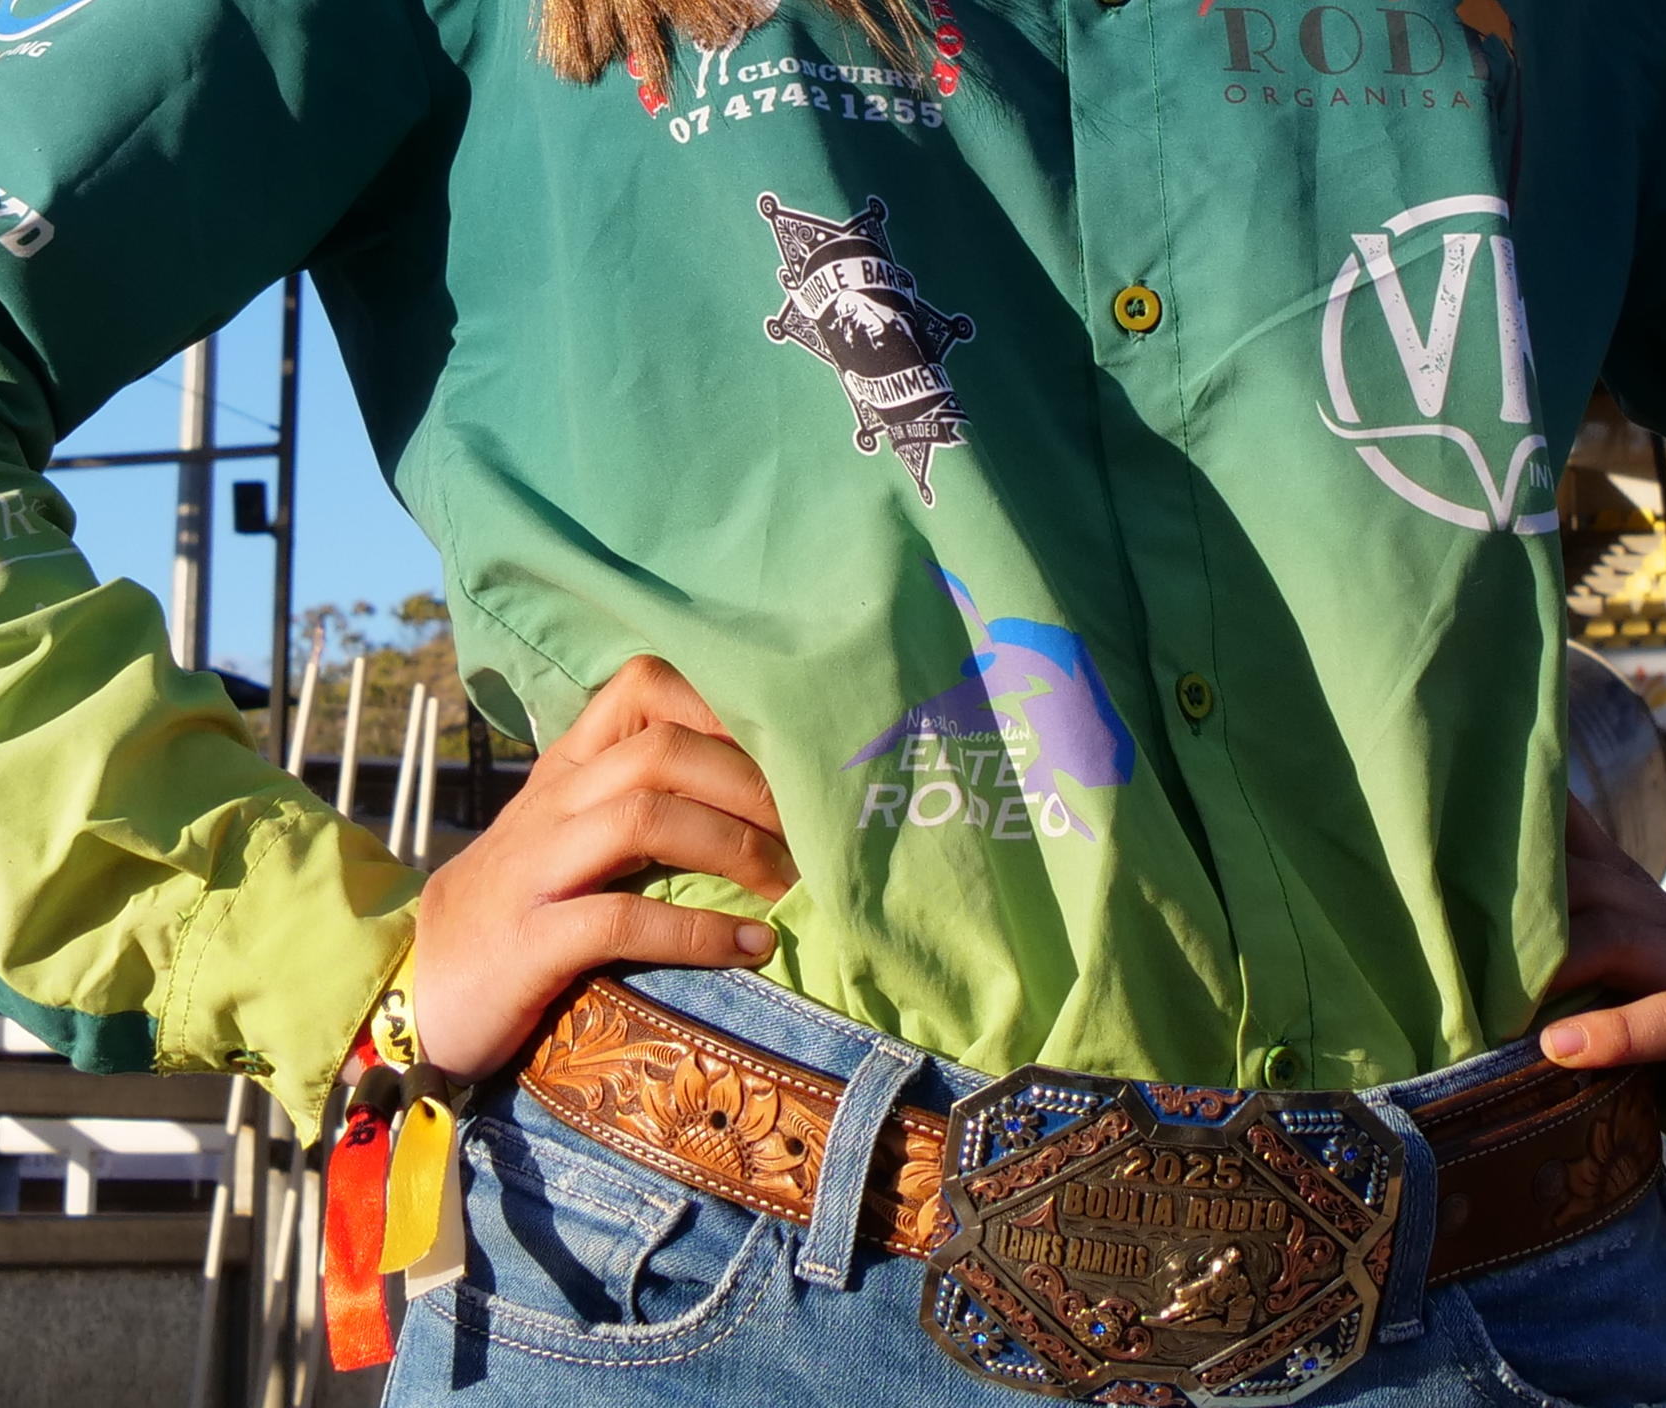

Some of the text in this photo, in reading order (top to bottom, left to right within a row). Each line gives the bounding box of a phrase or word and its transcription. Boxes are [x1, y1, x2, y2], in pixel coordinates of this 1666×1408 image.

[737, 56, 925, 91] CLONCURRY
[669, 82, 944, 144] 07 4742 1255
[899, 733, 1026, 789] ELITE
[856, 781, 1070, 840] RODEO
[1123, 1145, 1244, 1190] 2025
[1064, 1181, 1288, 1234] BOULIA RODEO
[998, 1224, 1149, 1279] LADIES BARRELS
